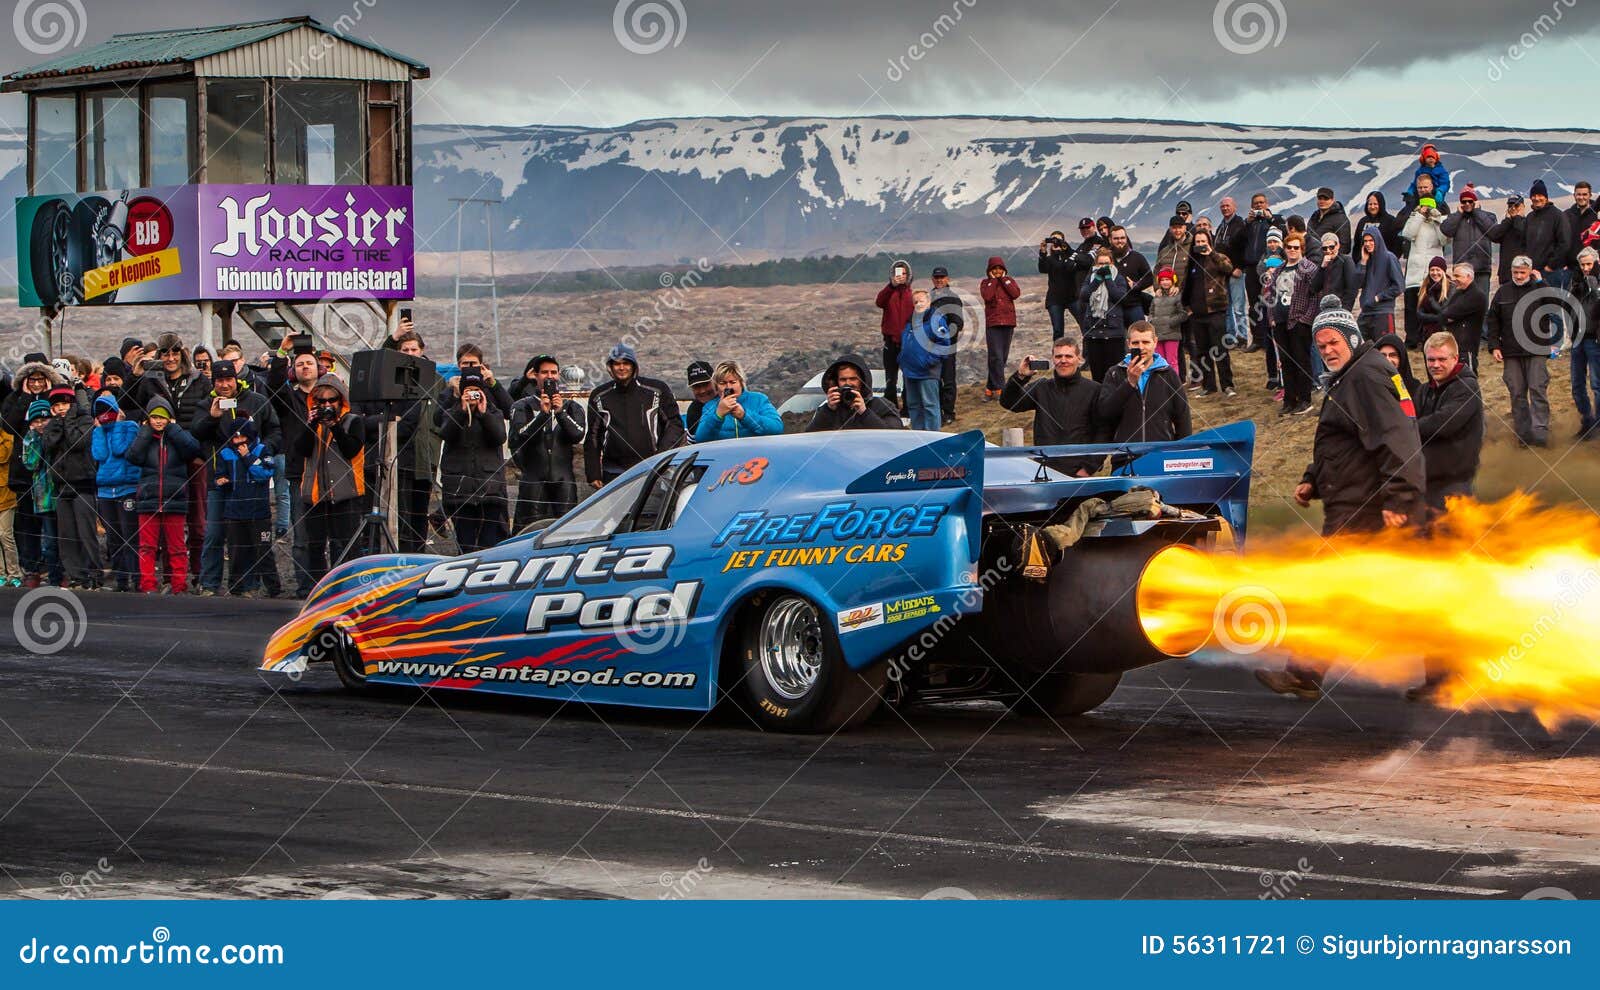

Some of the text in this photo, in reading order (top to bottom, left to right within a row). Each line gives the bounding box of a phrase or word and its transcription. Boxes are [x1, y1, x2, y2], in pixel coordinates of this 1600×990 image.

[135, 220, 160, 246] BJB
[211, 191, 407, 256] Hoosier
[270, 248, 392, 262] RACING TIRE
[109, 268, 120, 287] er
[121, 256, 161, 284] keppnis
[216, 267, 408, 293] Hönnuð fyrir meistara!
[737, 457, 769, 486] 3
[417, 543, 674, 600] Santa
[721, 543, 909, 573] JET FUNNY CARS
[526, 577, 704, 634] Pod
[376, 657, 697, 690] www.santapod.com
[760, 698, 788, 718] EAGLE
